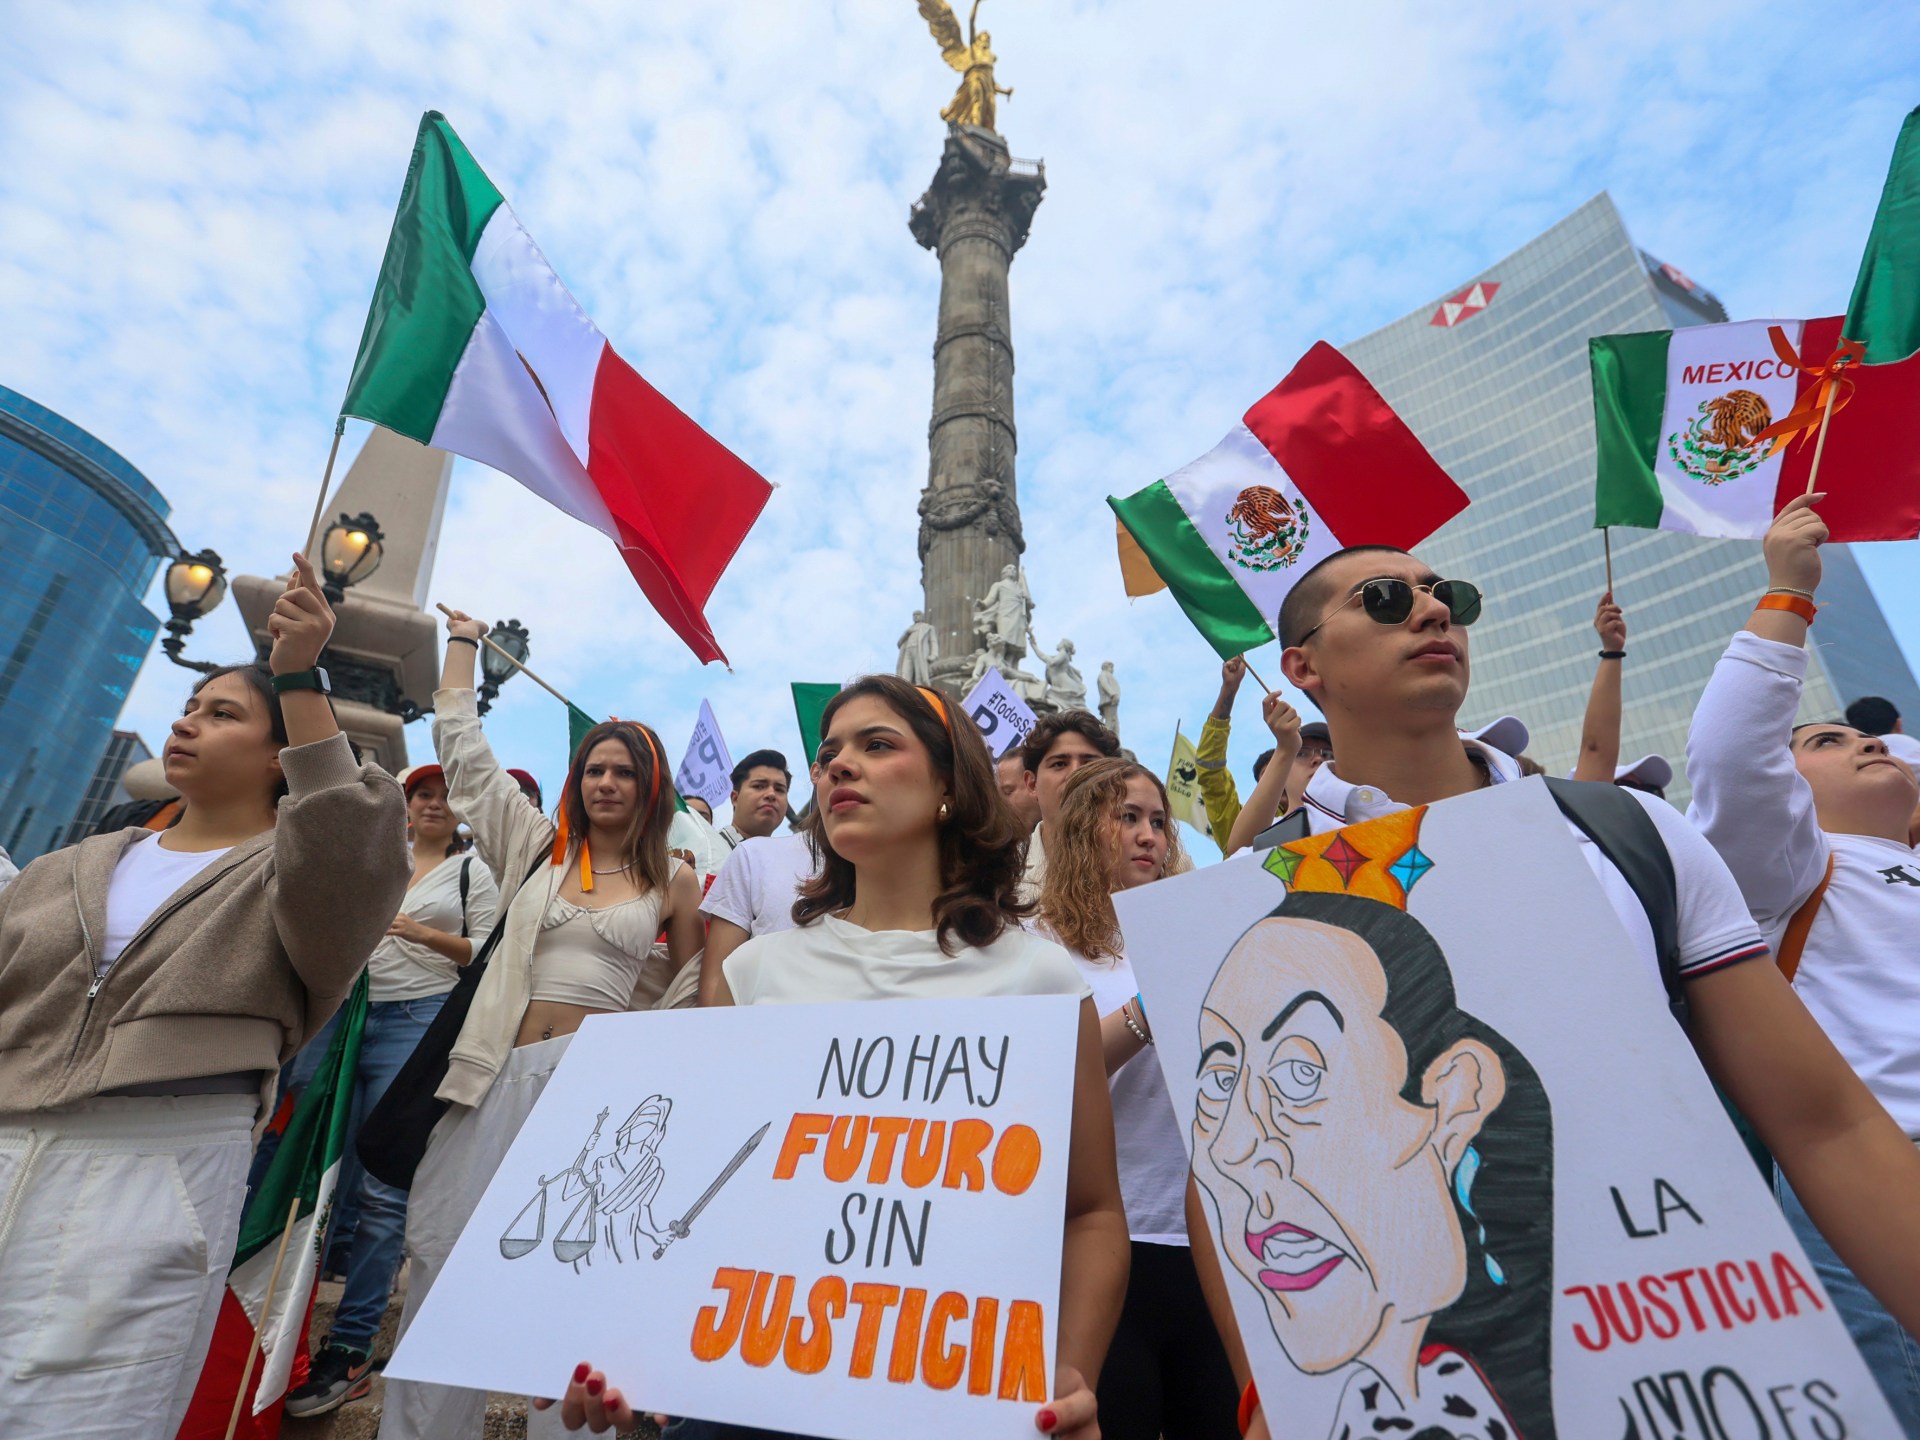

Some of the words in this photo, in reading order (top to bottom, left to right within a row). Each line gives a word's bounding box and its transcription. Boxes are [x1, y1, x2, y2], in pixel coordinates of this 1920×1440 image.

[1682, 359, 1796, 384] MEXICO
[817, 1036, 894, 1100] NO
[902, 1034, 1009, 1107] HAY
[772, 1112, 1042, 1197] FUTURO
[825, 1192, 932, 1268] SIN
[1609, 1178, 1704, 1239] LA
[690, 1267, 1048, 1404] JUSTICIA
[1563, 1251, 1824, 1352] JUSTICIA
